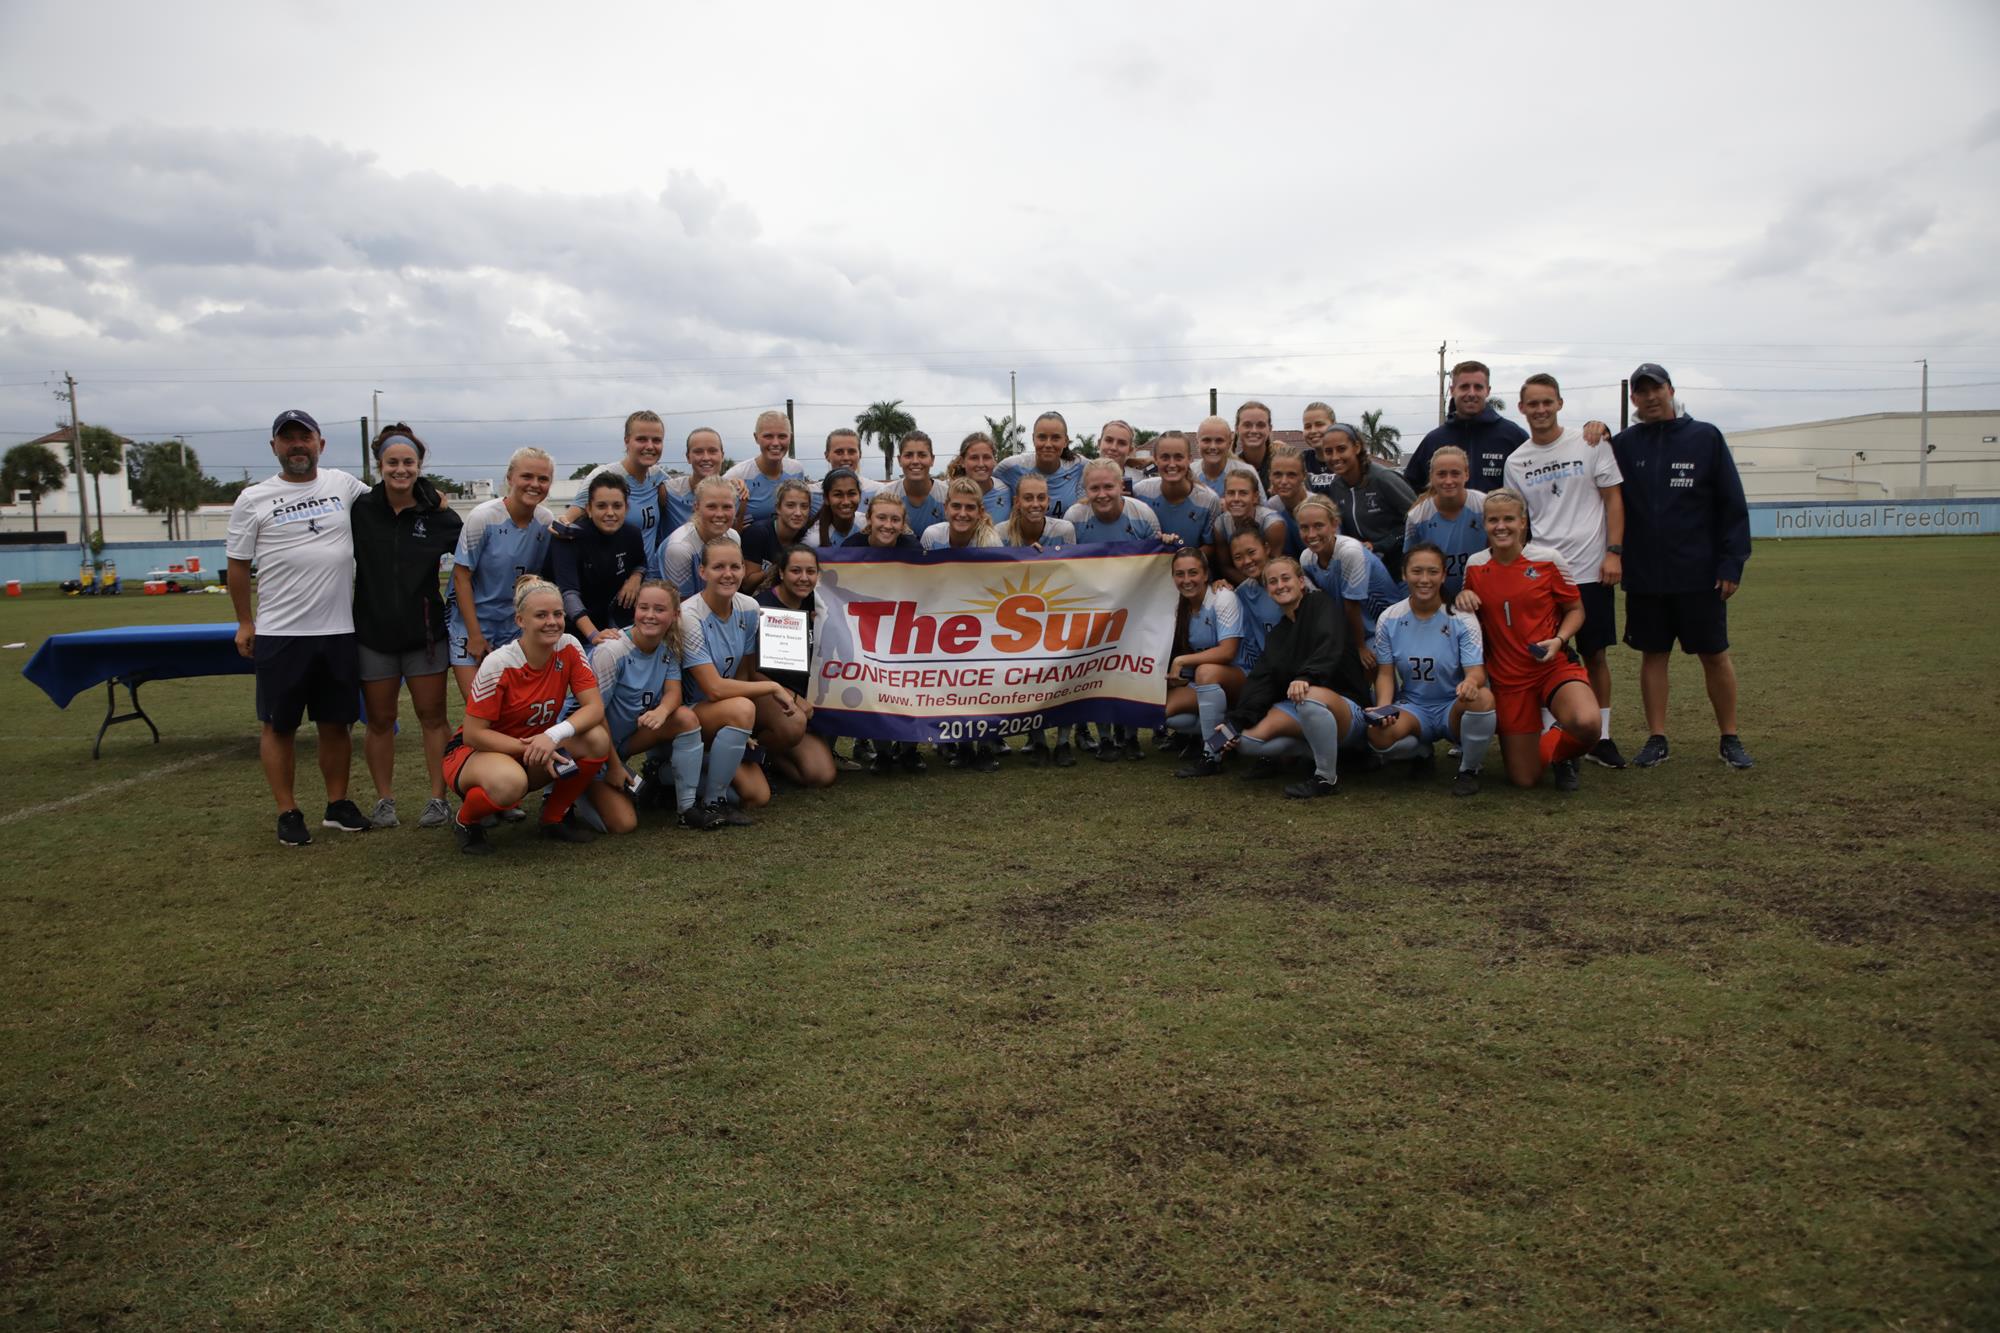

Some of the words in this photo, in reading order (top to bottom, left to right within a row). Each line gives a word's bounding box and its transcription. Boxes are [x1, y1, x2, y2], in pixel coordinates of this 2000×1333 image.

[1525, 460, 1585, 487] SOCCER
[273, 496, 344, 524] SOCCER
[641, 505, 656, 530] 16
[1776, 508, 1877, 529] Individual
[1883, 508, 1980, 527] Freedom
[767, 616, 783, 625] The
[783, 617, 800, 626] Sun
[847, 601, 982, 654] The
[990, 595, 1128, 654] Sun
[1503, 600, 1512, 626] 1
[822, 661, 996, 689] CONFERENCE
[1004, 654, 1156, 686] CHAMPIONS
[1408, 657, 1435, 681] 32
[878, 679, 1104, 708] www.TheSunConference.com
[527, 699, 556, 727] 26
[938, 713, 1044, 741] 2019-2020
